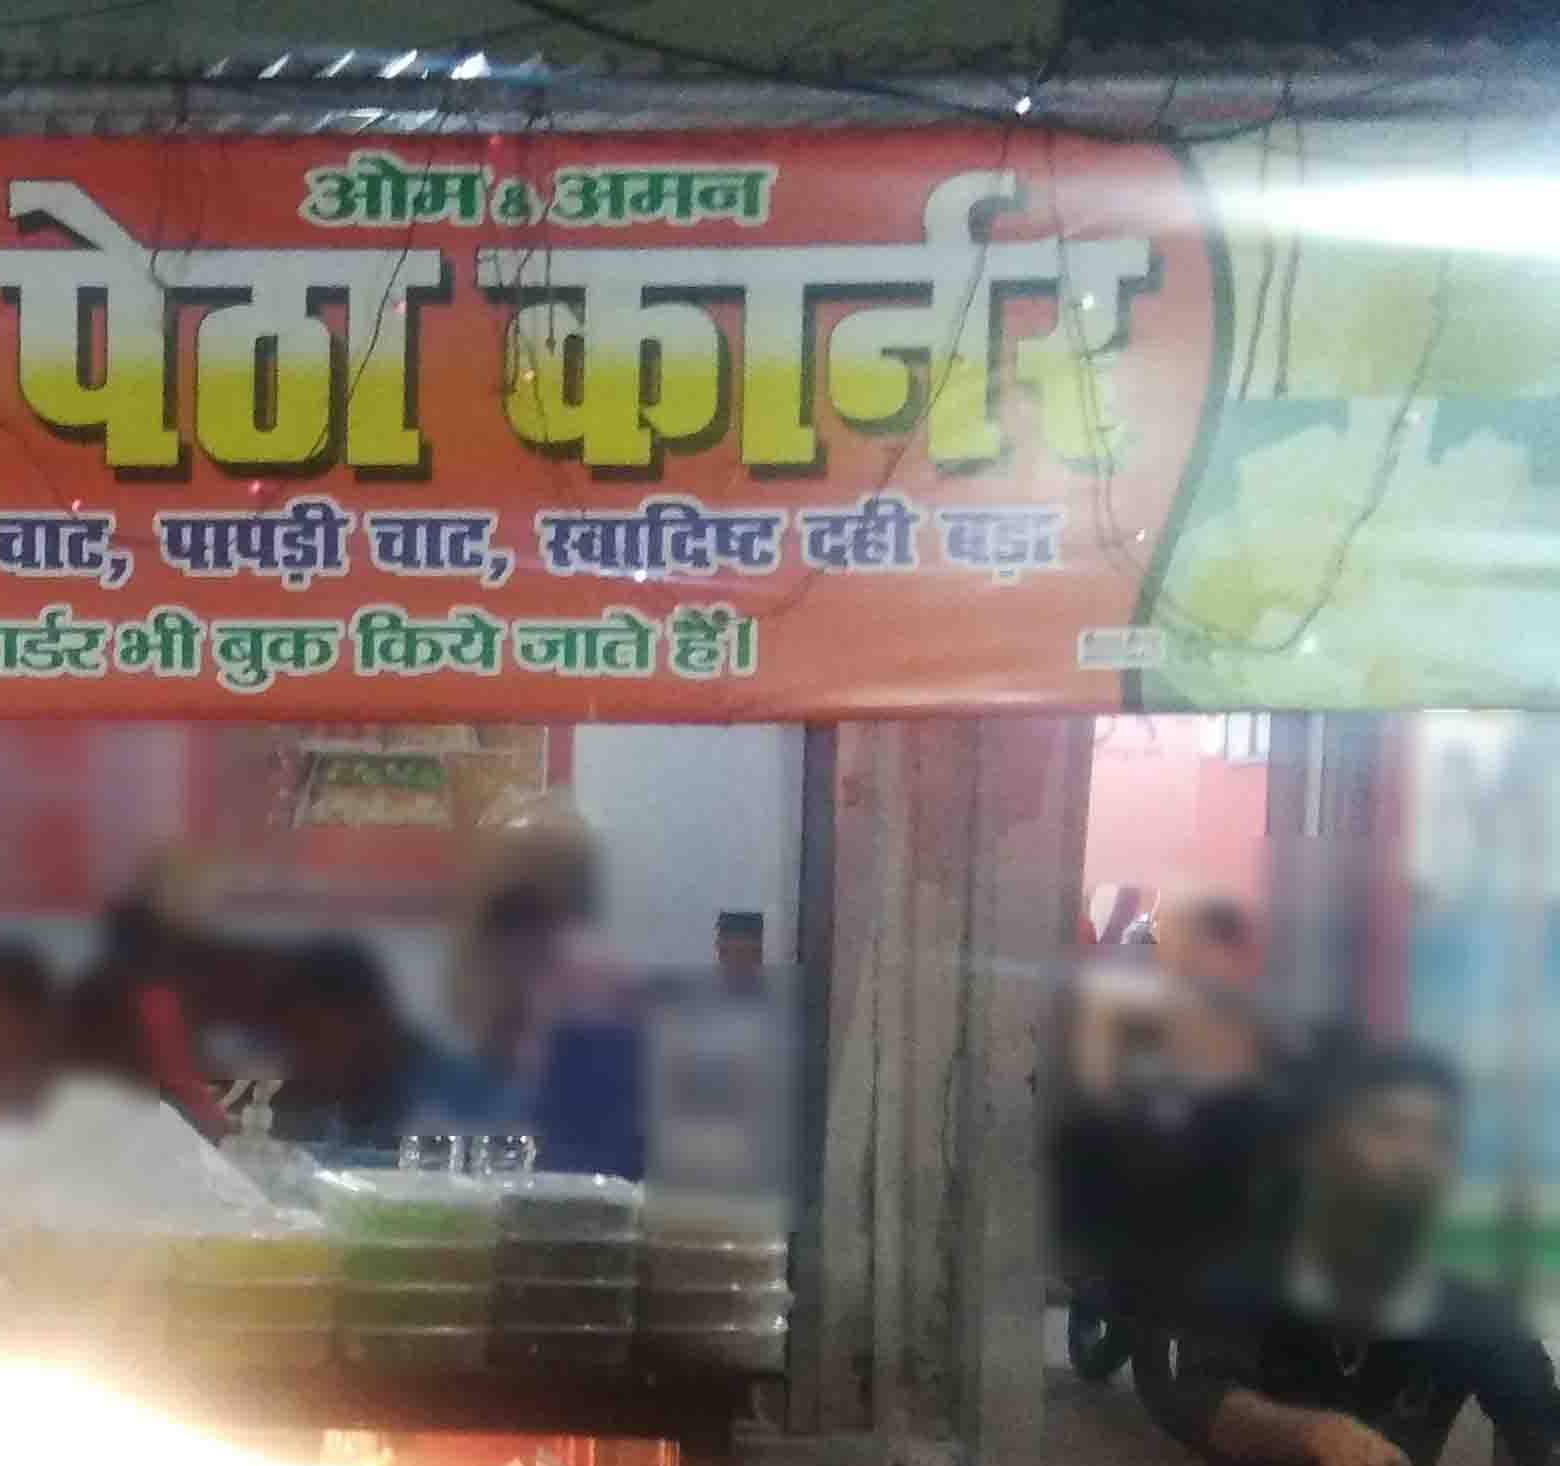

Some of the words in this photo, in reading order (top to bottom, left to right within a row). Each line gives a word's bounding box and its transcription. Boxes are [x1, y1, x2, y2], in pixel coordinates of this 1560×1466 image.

[304, 156, 487, 222] ओम
[550, 168, 772, 222] अमन
[475, 170, 1156, 474] कार्नर
[160, 502, 348, 582] पापड़ी
[369, 517, 508, 580] चाट,
[542, 503, 780, 568] स्वादिष्ट
[804, 501, 917, 566] दही
[118, 610, 200, 670] भी
[216, 626, 335, 686] बुक
[357, 612, 502, 670] किये
[517, 613, 653, 668] जाते
